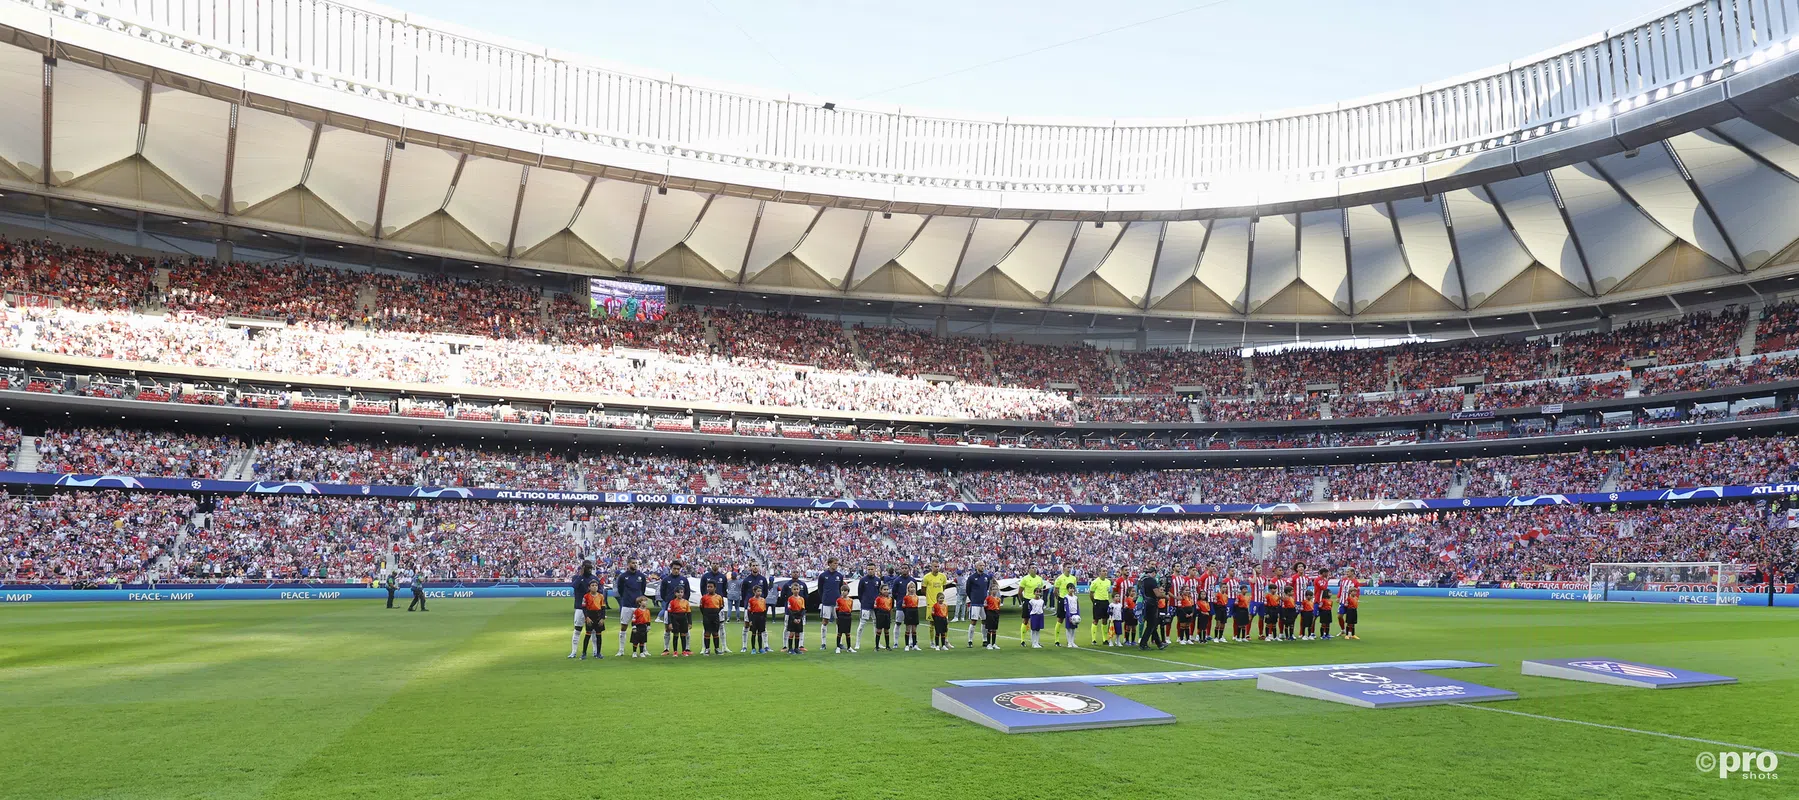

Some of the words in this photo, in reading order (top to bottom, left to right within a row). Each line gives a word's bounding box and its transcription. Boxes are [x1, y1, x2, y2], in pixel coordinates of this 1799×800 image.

[497, 490, 546, 499] ATLÉTICO
[562, 493, 599, 501] MADRID
[636, 494, 667, 503] 00:00
[702, 496, 755, 504] FEYENOORD
[6, 593, 32, 602] МИР
[129, 593, 160, 601] PEACE
[170, 592, 194, 600] МИР
[281, 591, 310, 599] PEACE
[319, 591, 341, 599] МИР
[1551, 592, 1575, 600] PEACE
[1678, 595, 1709, 603] PEACE
